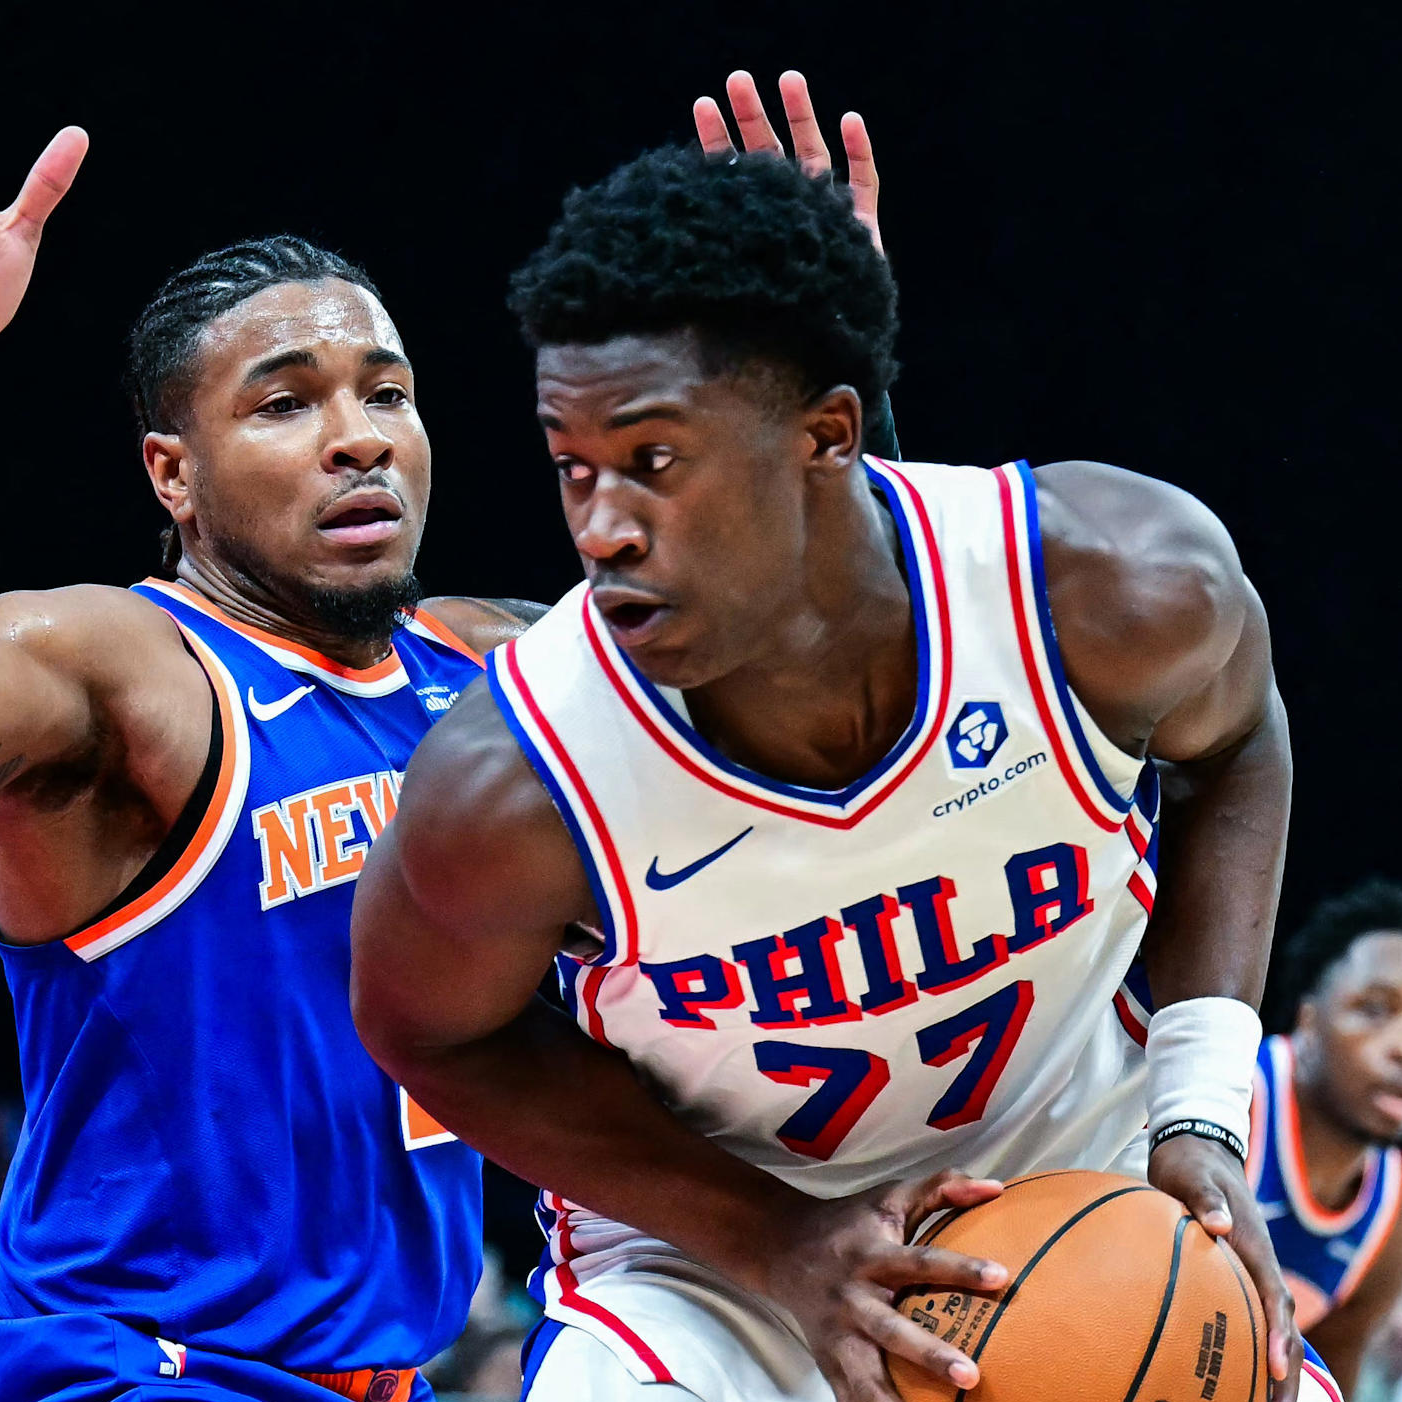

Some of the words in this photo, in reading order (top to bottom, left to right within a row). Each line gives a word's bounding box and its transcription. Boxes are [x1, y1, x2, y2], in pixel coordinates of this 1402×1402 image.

[932, 751, 1047, 818] crypto.com
[639, 842, 1095, 1030] PHILA
[753, 979, 1034, 1161] 77
[1195, 1122, 1227, 1141] YOUR
